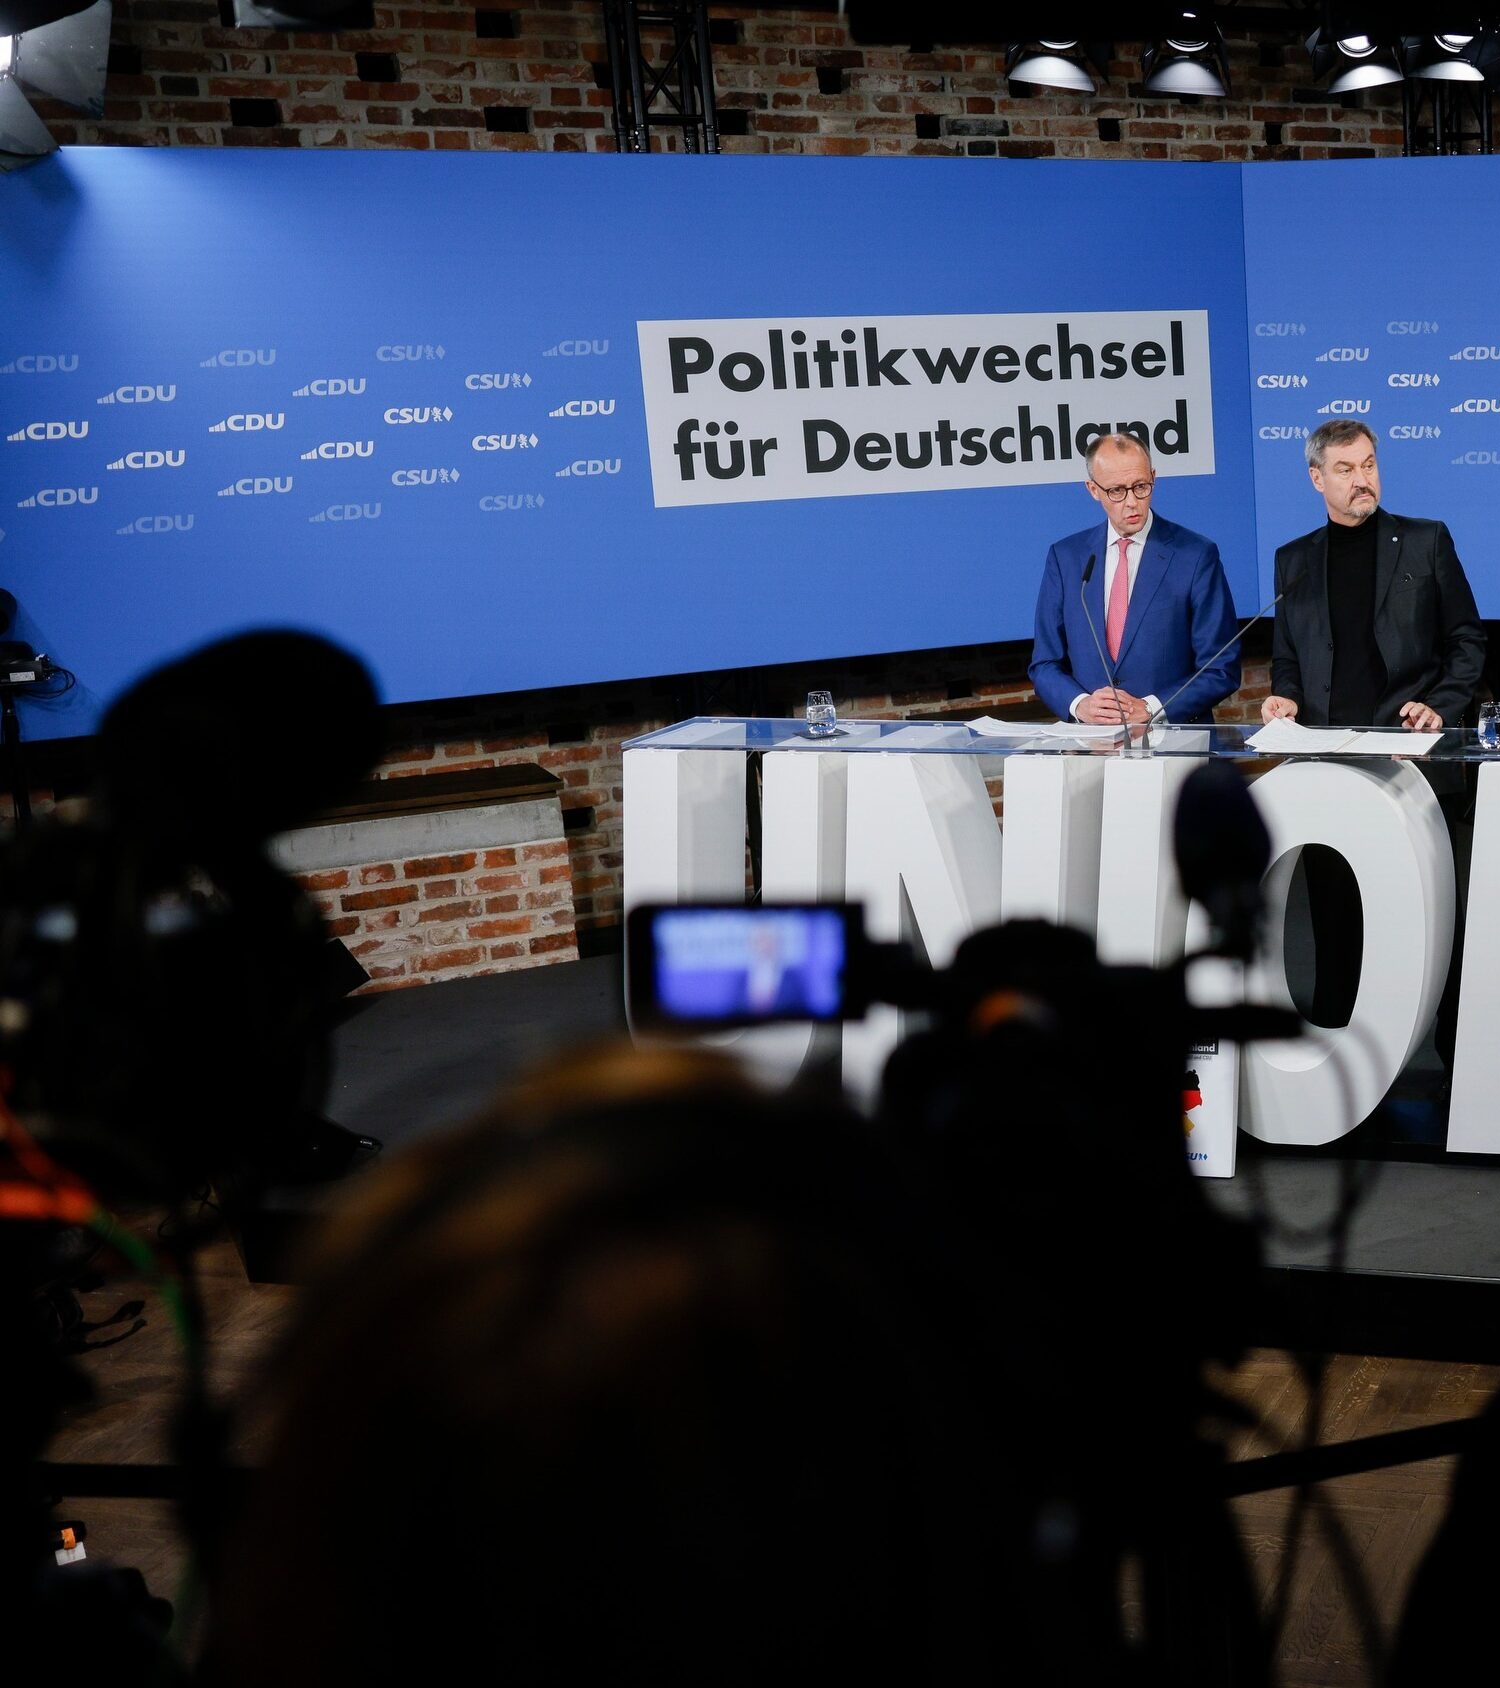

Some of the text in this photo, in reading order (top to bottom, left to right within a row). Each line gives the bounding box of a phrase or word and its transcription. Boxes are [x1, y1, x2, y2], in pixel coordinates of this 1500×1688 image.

[1254, 322, 1291, 337] CSU
[1386, 320, 1422, 335] CSU
[375, 344, 423, 362] CSU
[558, 339, 609, 357] CDU
[667, 320, 1186, 394] Politikwechsel
[1328, 347, 1370, 362] CDU
[16, 353, 80, 373] CDU
[217, 349, 276, 367] CDU
[309, 378, 367, 396] CDU
[464, 373, 511, 390] CSU
[1256, 374, 1292, 389] CSU
[1387, 373, 1424, 388] CSU
[115, 384, 177, 403] CDU
[564, 399, 616, 417] CDU
[1329, 399, 1371, 414] CDU
[226, 412, 285, 432] CDU
[383, 407, 431, 425] CSU
[26, 420, 89, 441] CDU
[1258, 426, 1294, 440] CSU
[1388, 425, 1425, 440] CSU
[318, 440, 374, 459] CDU
[471, 434, 517, 451] CSU
[673, 418, 778, 481] für
[125, 449, 186, 469] CDU
[571, 458, 622, 476] CDU
[235, 476, 293, 495] CDU
[391, 468, 438, 486] CSU
[36, 486, 99, 507] CDU
[479, 494, 524, 512] CSU
[326, 502, 382, 522] CDU
[134, 513, 195, 534] CDU
